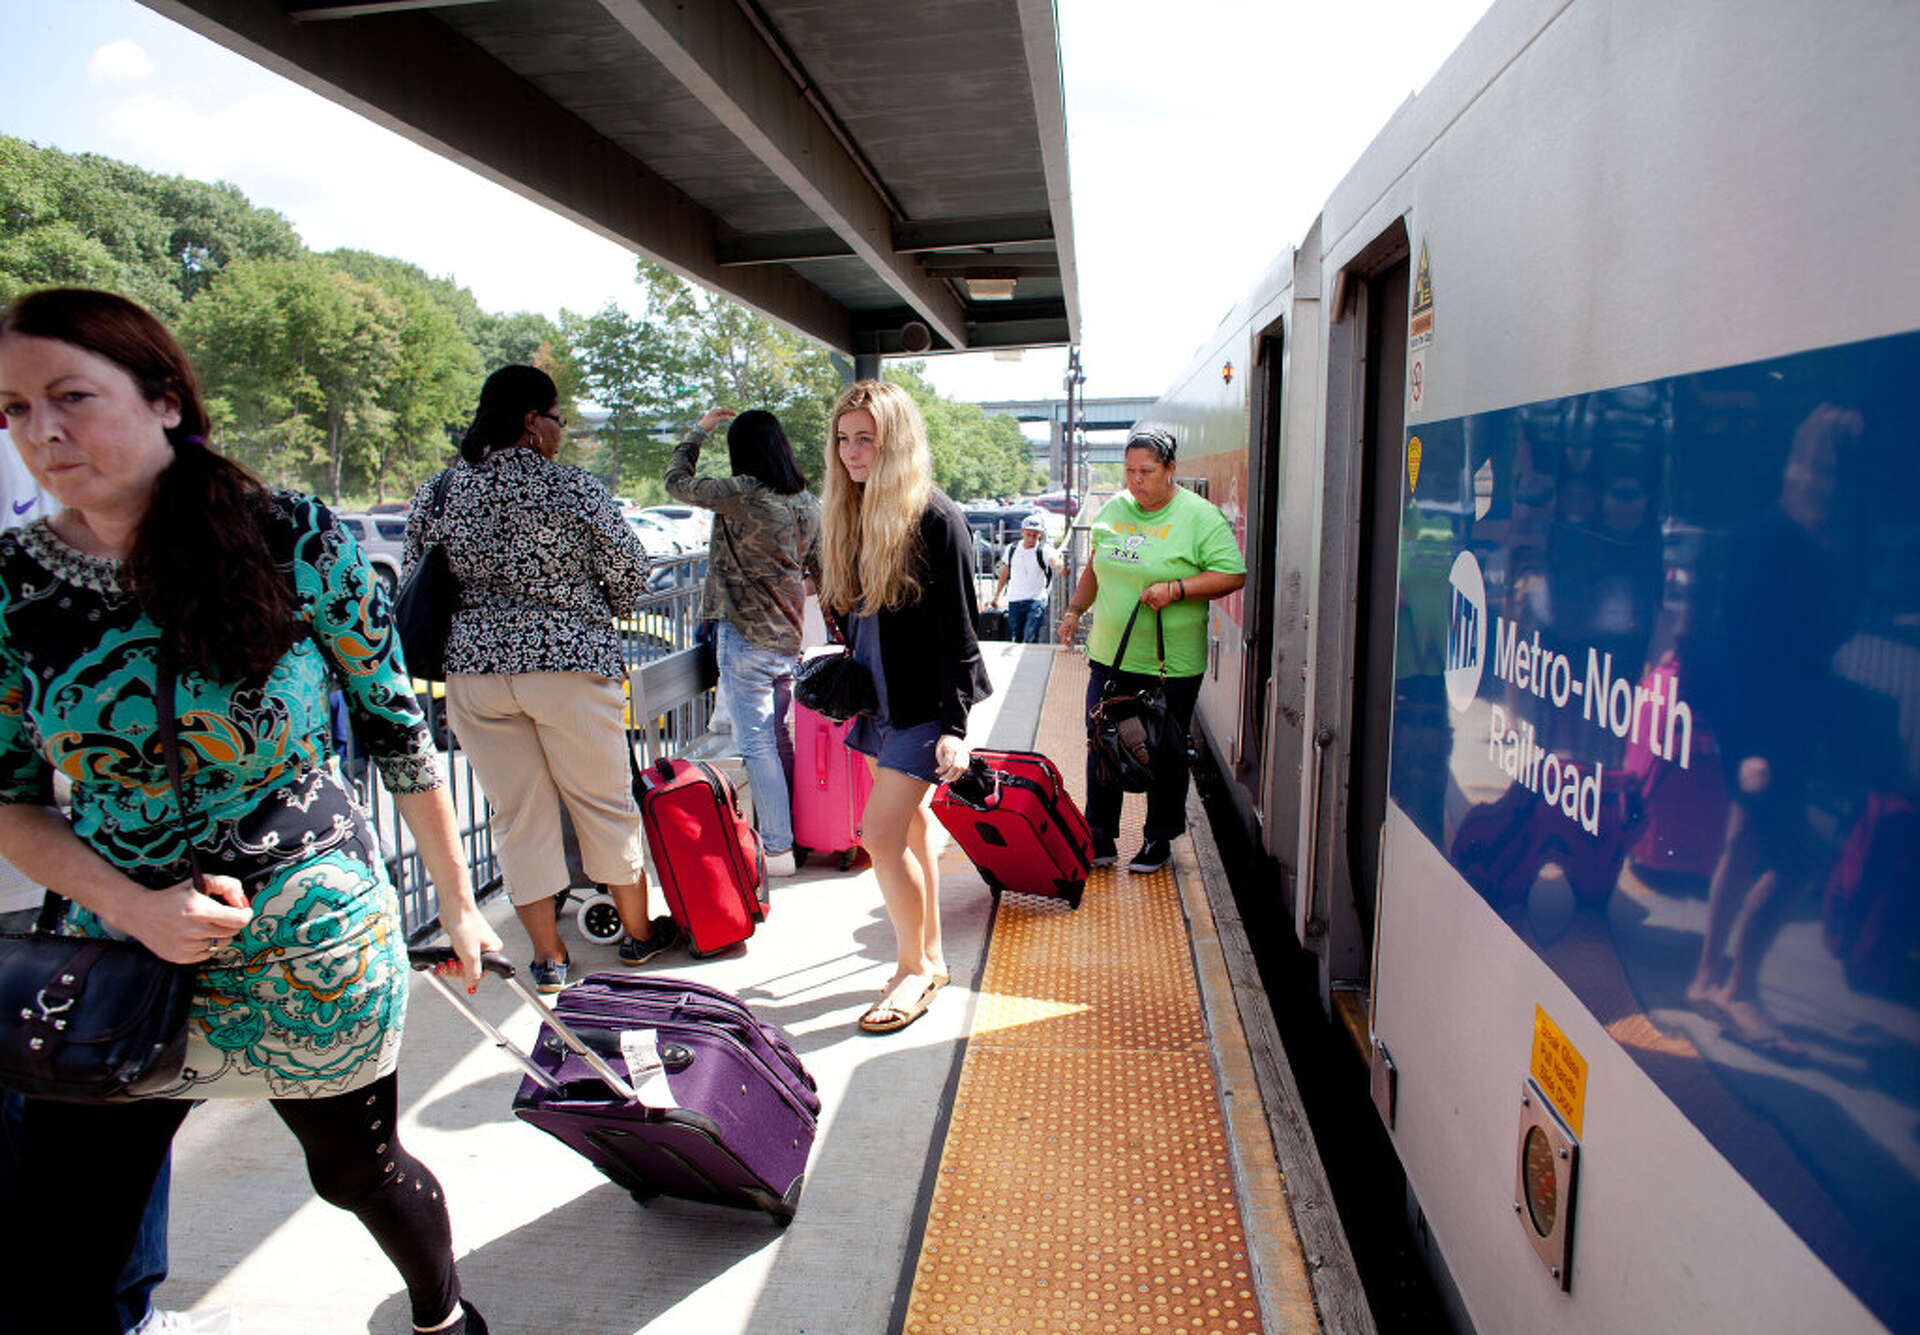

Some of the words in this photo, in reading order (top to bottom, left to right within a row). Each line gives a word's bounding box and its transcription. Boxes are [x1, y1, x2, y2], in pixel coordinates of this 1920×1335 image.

[1447, 584, 1479, 671] MTA
[1494, 616, 1693, 770] Metro-North
[1489, 703, 1603, 837] Railroad
